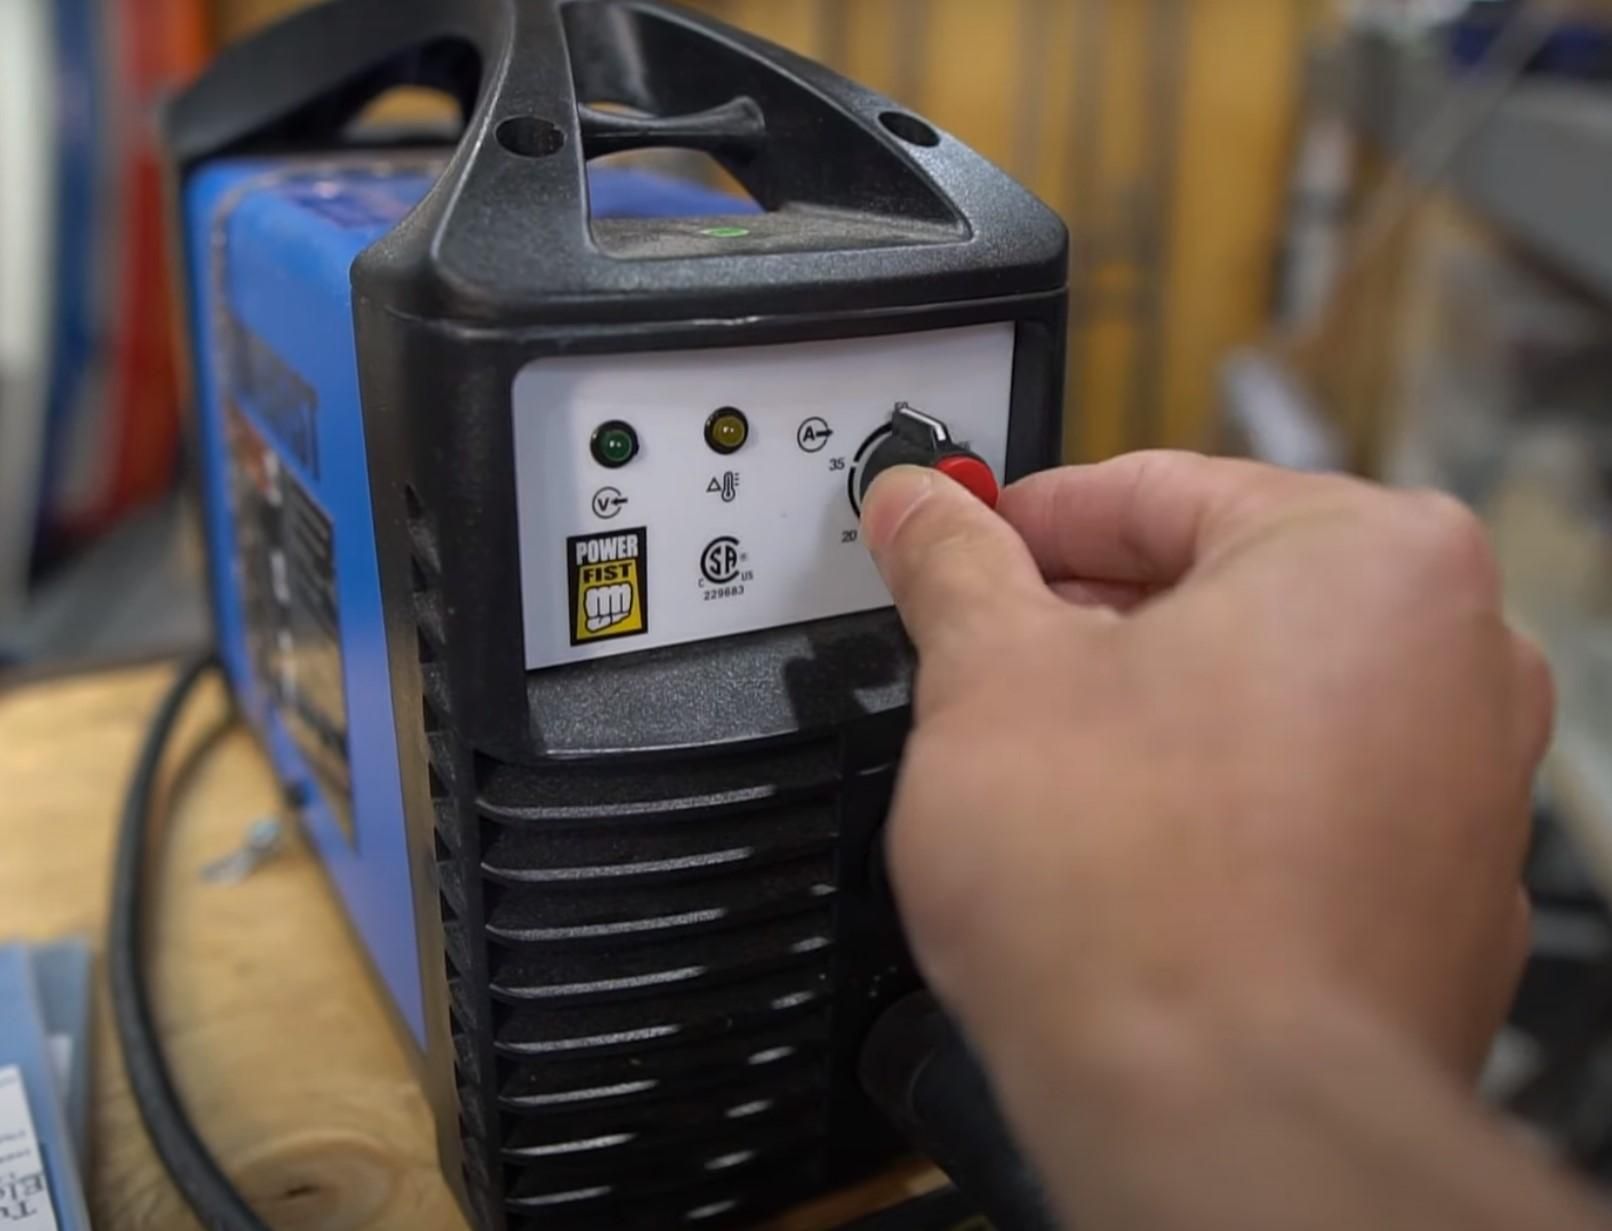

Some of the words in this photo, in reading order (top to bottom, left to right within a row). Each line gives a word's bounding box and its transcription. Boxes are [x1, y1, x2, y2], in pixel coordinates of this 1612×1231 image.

[803, 427, 816, 442] A
[829, 458, 845, 471] 35
[841, 530, 857, 543] 20
[576, 534, 638, 565] POWER
[583, 563, 632, 583] FIST
[741, 571, 753, 581] US
[704, 586, 744, 600] 229683
